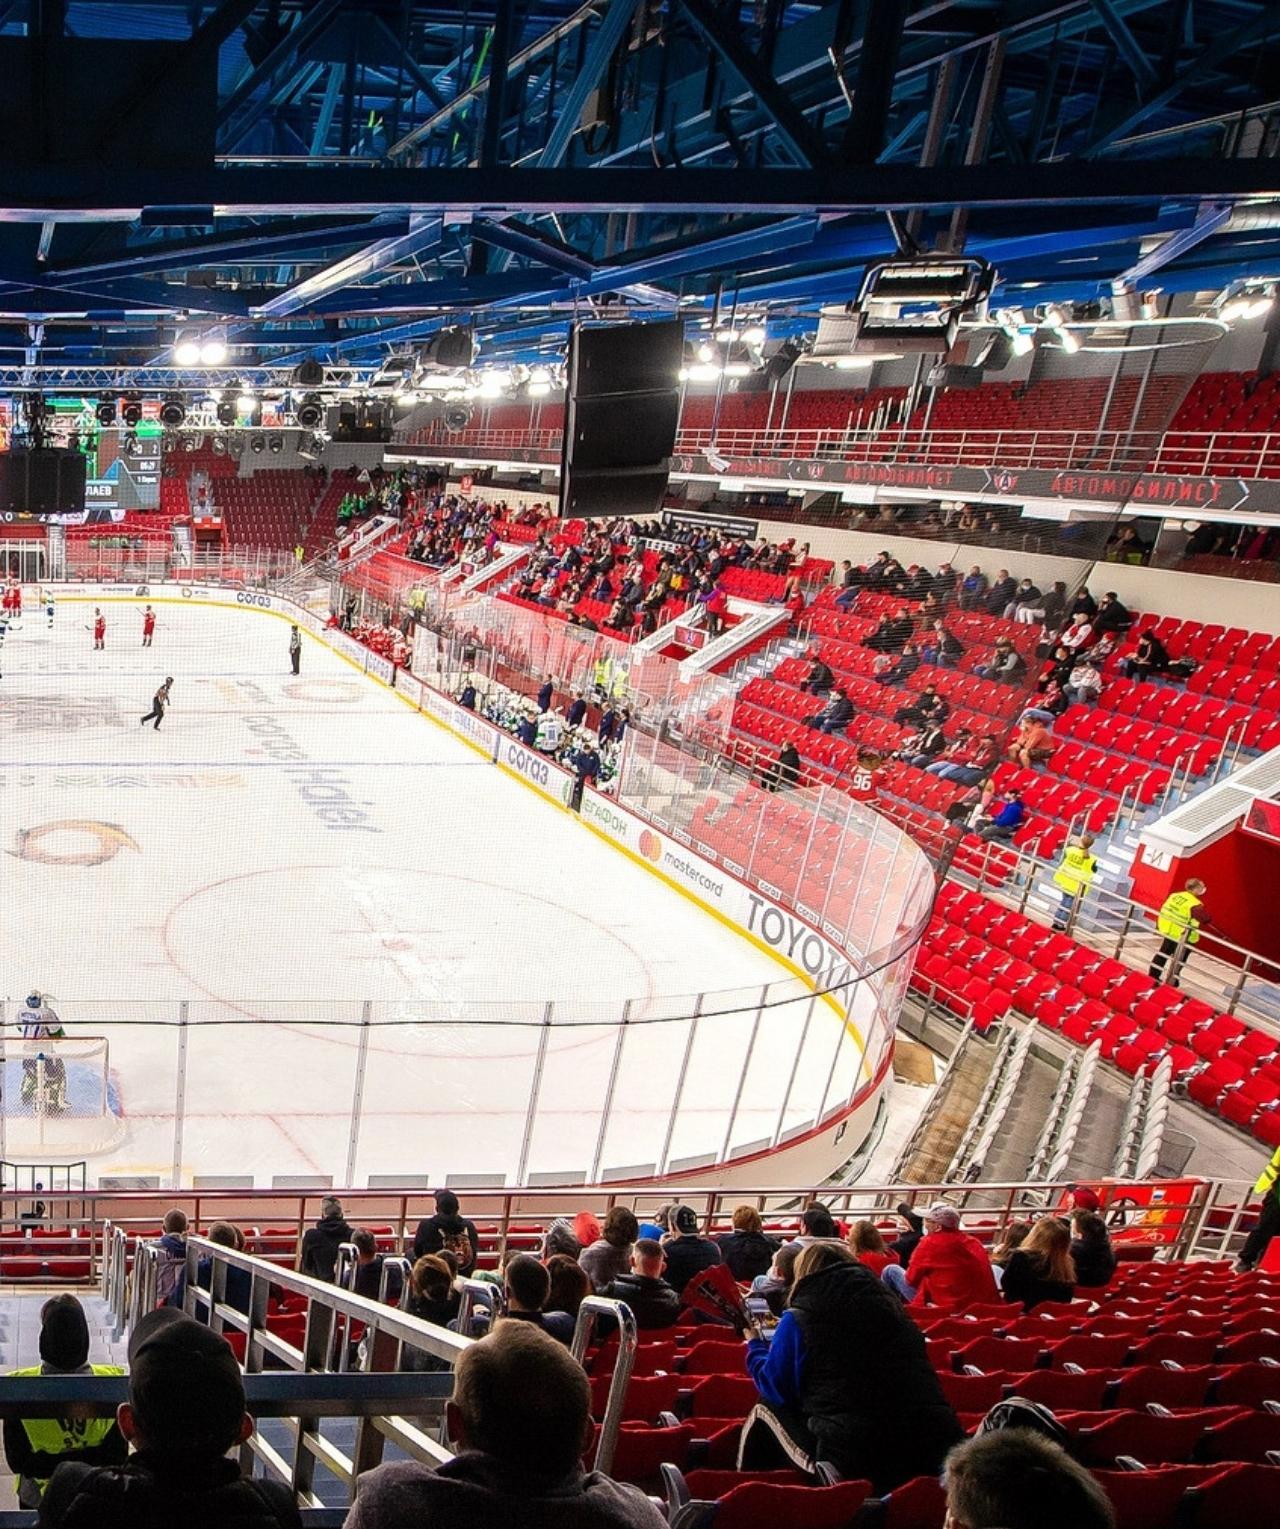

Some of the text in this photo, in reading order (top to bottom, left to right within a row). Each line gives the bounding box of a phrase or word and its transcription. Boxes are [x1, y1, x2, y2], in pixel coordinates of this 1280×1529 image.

[85, 485, 112, 496] ЛАЕВ
[1051, 476, 1221, 502] АВТОМОБИЛИСТ
[237, 592, 270, 608] согаз
[508, 745, 549, 785] согаз
[853, 773, 872, 791] 96
[582, 796, 628, 836] ЕГАФОН
[664, 851, 724, 897] mastercard
[748, 893, 851, 1007] TOYOTA
